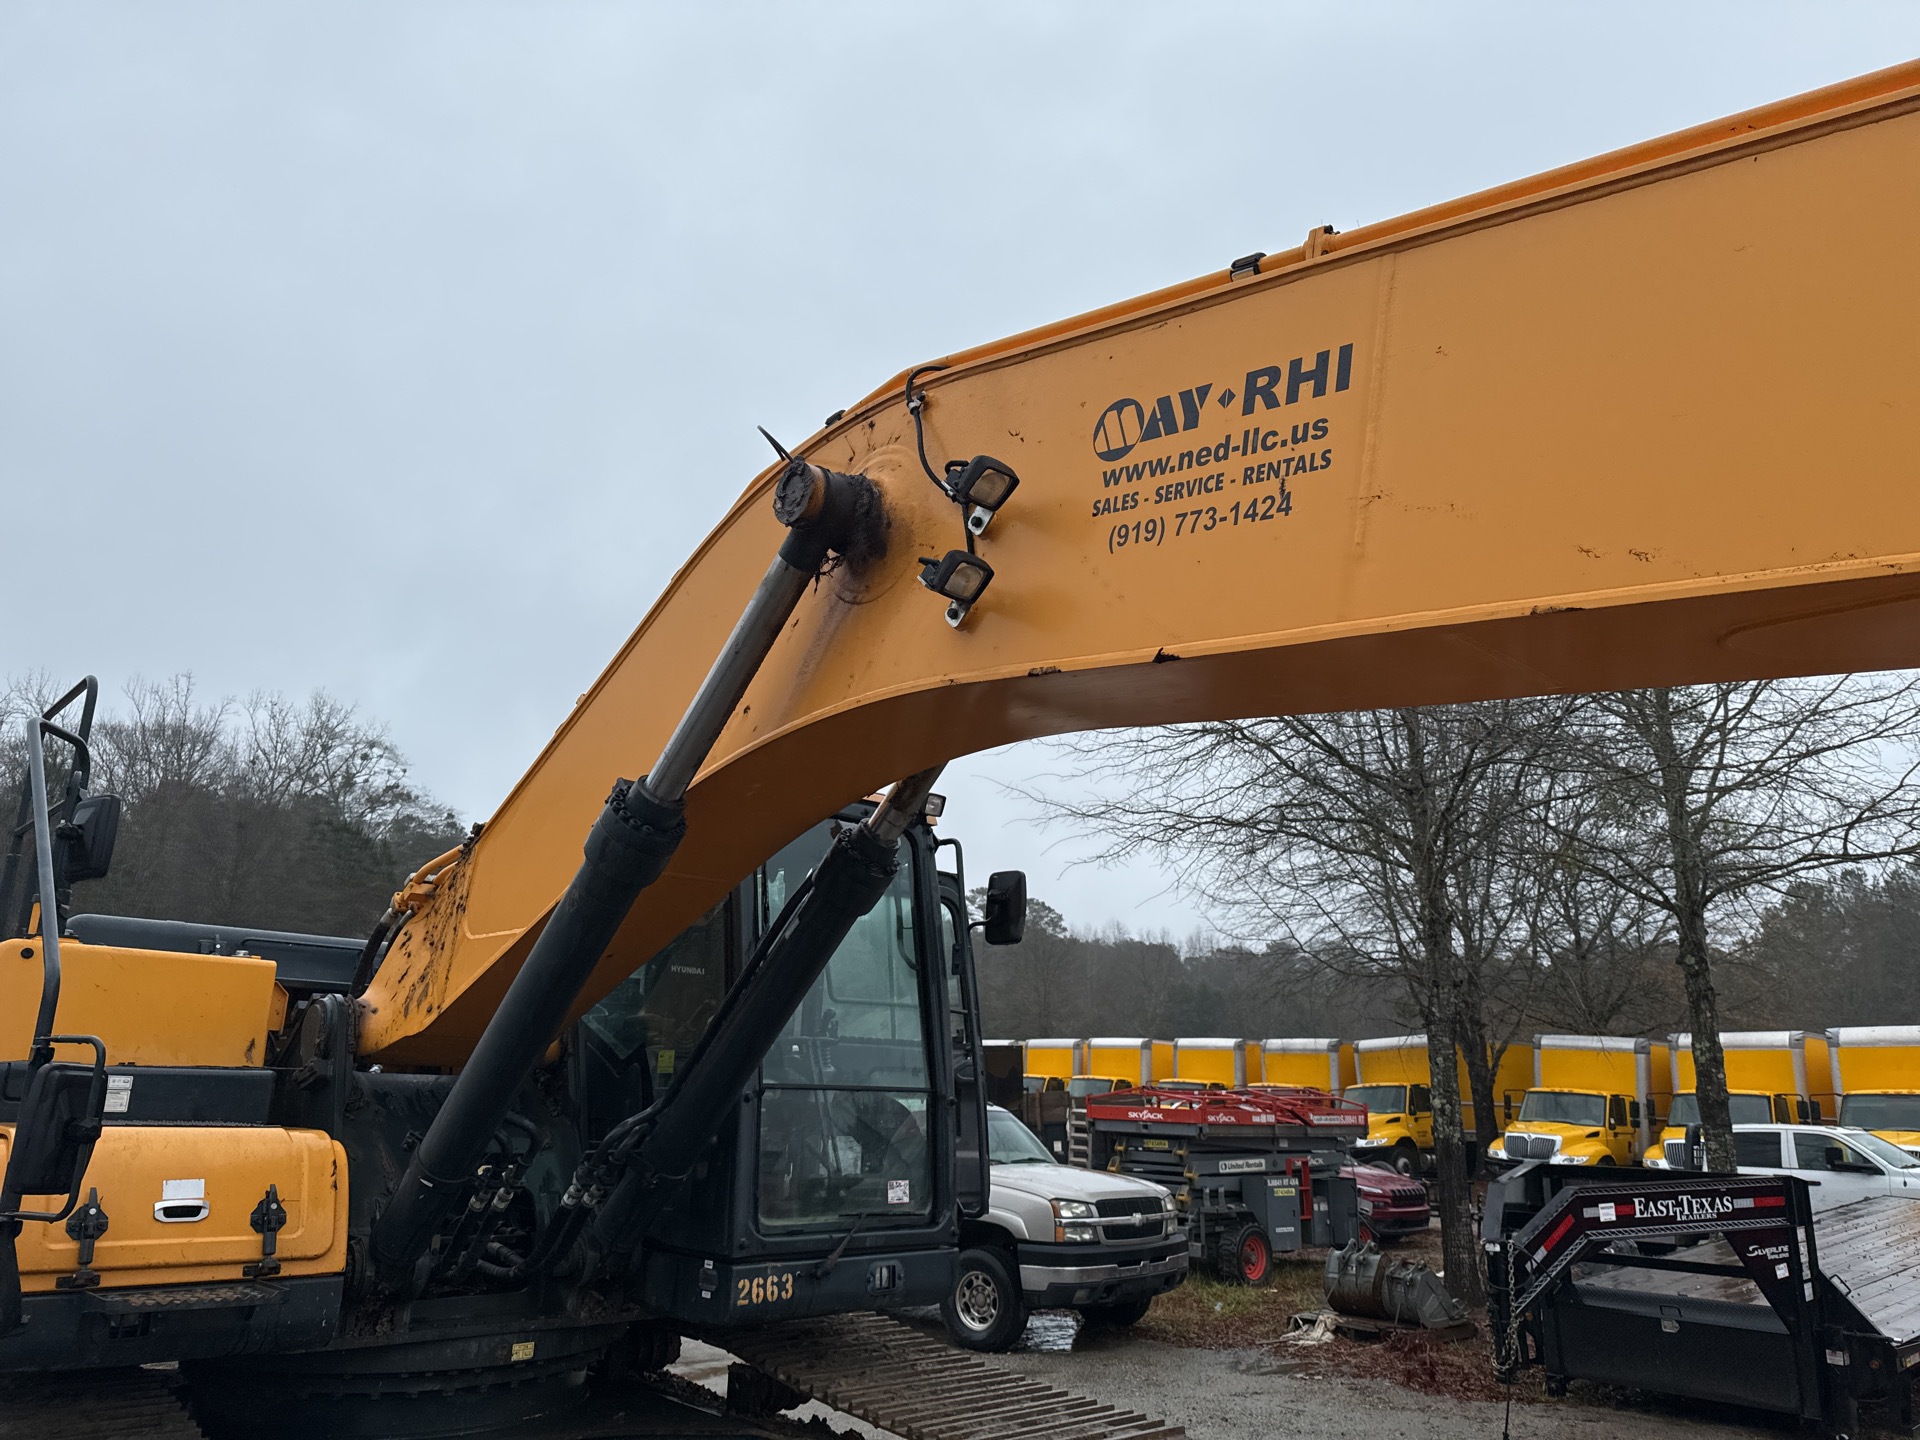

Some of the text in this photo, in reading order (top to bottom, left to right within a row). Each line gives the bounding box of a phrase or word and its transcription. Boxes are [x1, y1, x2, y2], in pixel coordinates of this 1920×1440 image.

[1241, 343, 1354, 416] RHI
[1102, 418, 1330, 488] www.ned-llc.us
[1092, 491, 1139, 517] SALES
[1154, 472, 1224, 504] SERVICE
[1242, 448, 1332, 485] RENTALS
[1108, 491, 1293, 554] (919) 773-1424
[671, 964, 705, 975] HYUNDAI
[1128, 1109, 1164, 1121] SKYJACK
[1207, 1112, 1236, 1123] SKYJACK
[1227, 1160, 1263, 1170] United Rentals
[1632, 1197, 1676, 1218] EAST
[1678, 1195, 1733, 1215] TEXAS
[1674, 1206, 1717, 1221] TRAILERS
[737, 1272, 794, 1306] 2663
